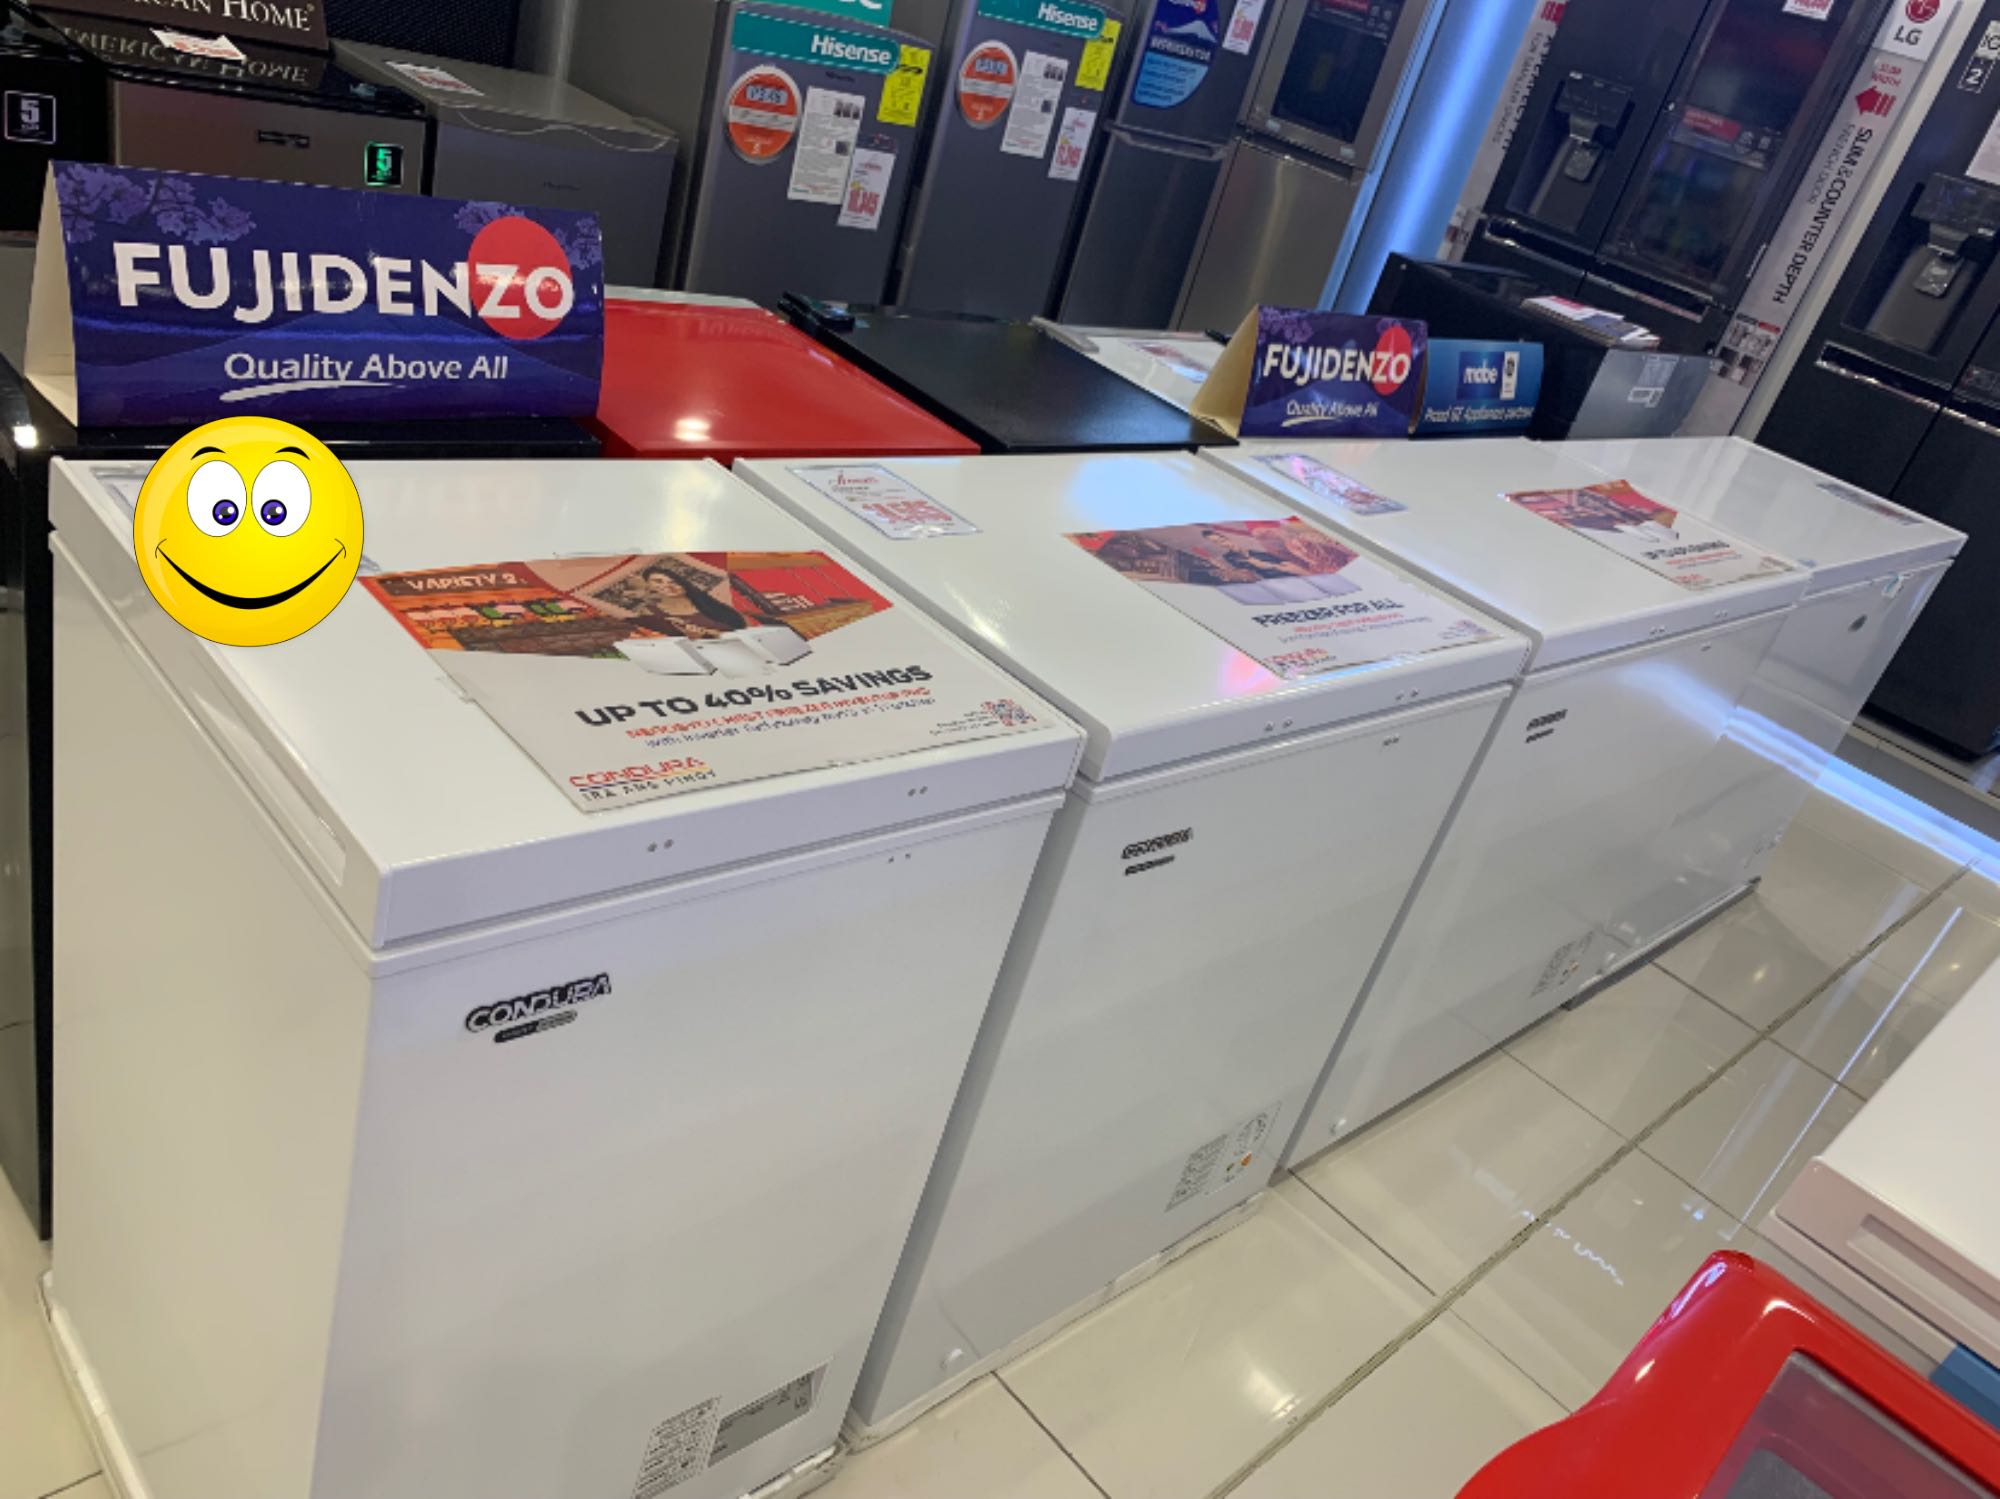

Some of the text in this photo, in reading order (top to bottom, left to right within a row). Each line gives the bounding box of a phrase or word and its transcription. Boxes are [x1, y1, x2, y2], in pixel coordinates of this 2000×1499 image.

[1037, 3, 1098, 31] Hisense
[810, 34, 892, 65] Hisense
[1893, 25, 1923, 46] LG
[1965, 68, 1984, 85] 2
[20, 97, 40, 123] 5
[113, 241, 574, 324] FUJIDENZO
[224, 353, 509, 382] Quality Above All
[1262, 344, 1411, 386] FUJIDENZO
[575, 665, 933, 727] UP TO 40% SAVINGS
[464, 972, 613, 1034] CONDURA
